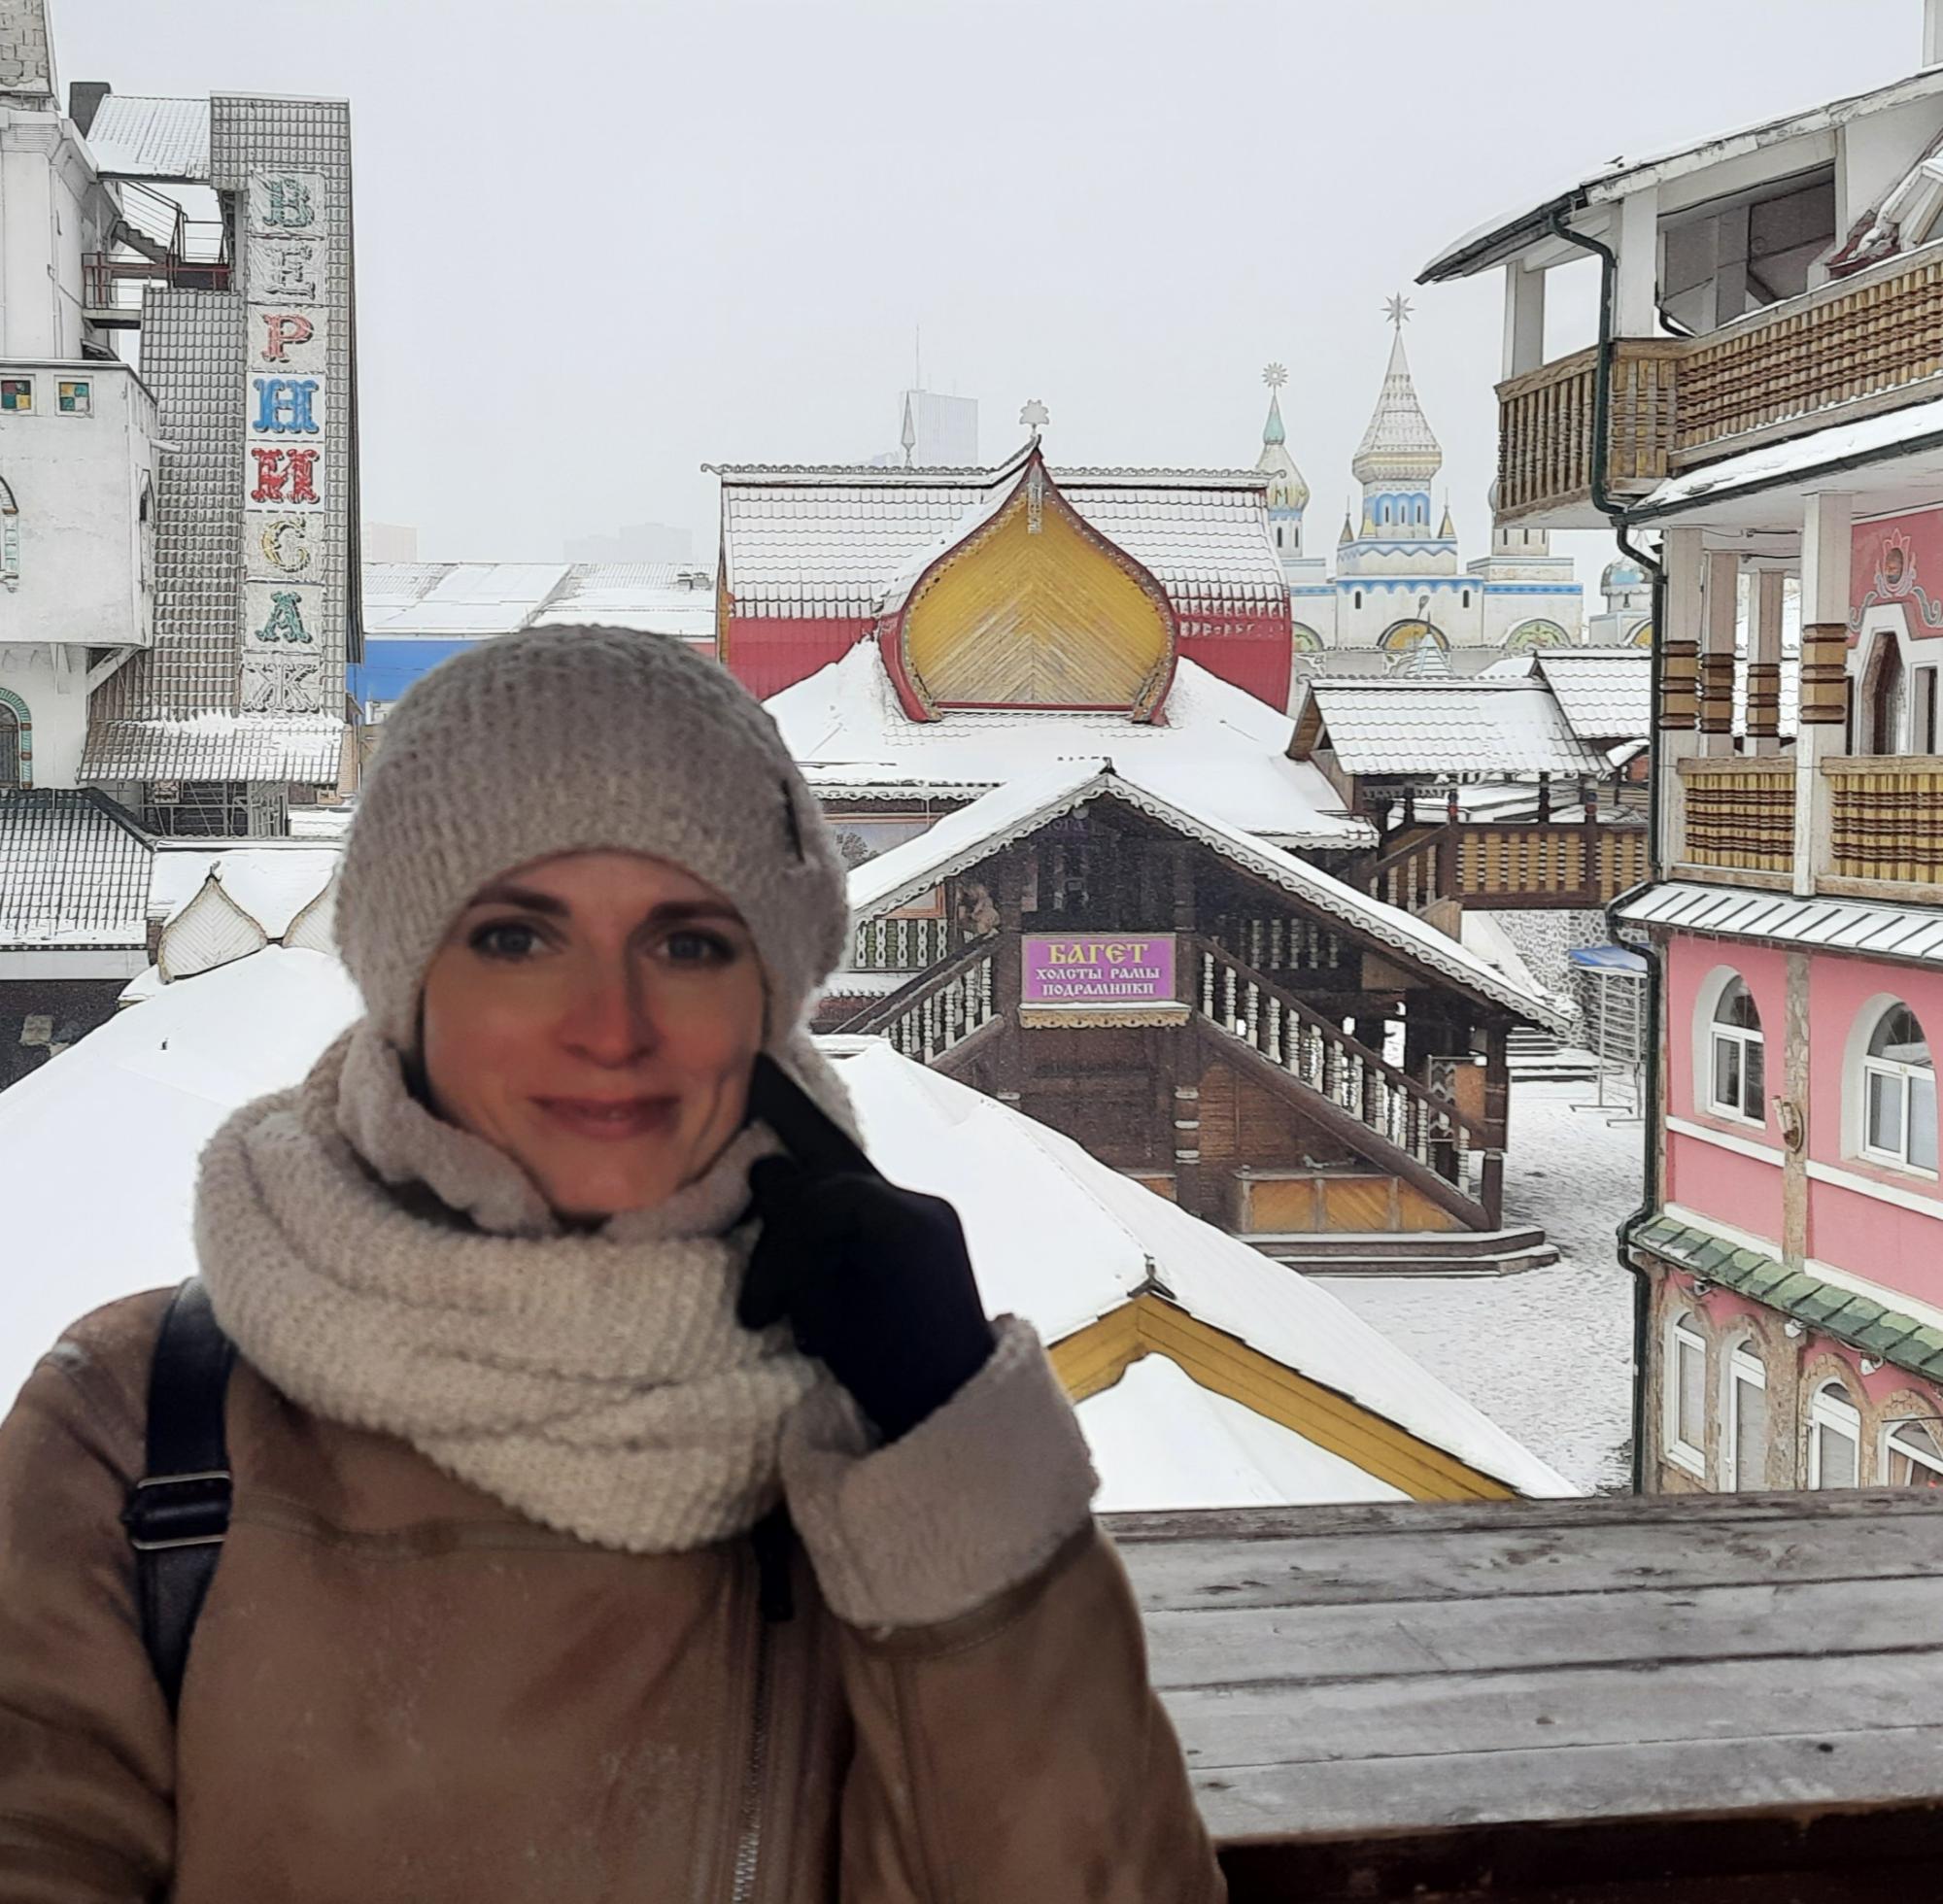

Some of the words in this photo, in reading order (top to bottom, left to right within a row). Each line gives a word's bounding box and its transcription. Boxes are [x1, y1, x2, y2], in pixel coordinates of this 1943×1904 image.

[243, 177, 321, 714] ВЕРНИСАЖ
[1048, 943, 1149, 965] БАГЕТ
[1036, 968, 1103, 980] ХОЛСТЫ
[1110, 968, 1160, 979] РАМЫ
[1042, 982, 1154, 997] ПОДРАМНИКИ
